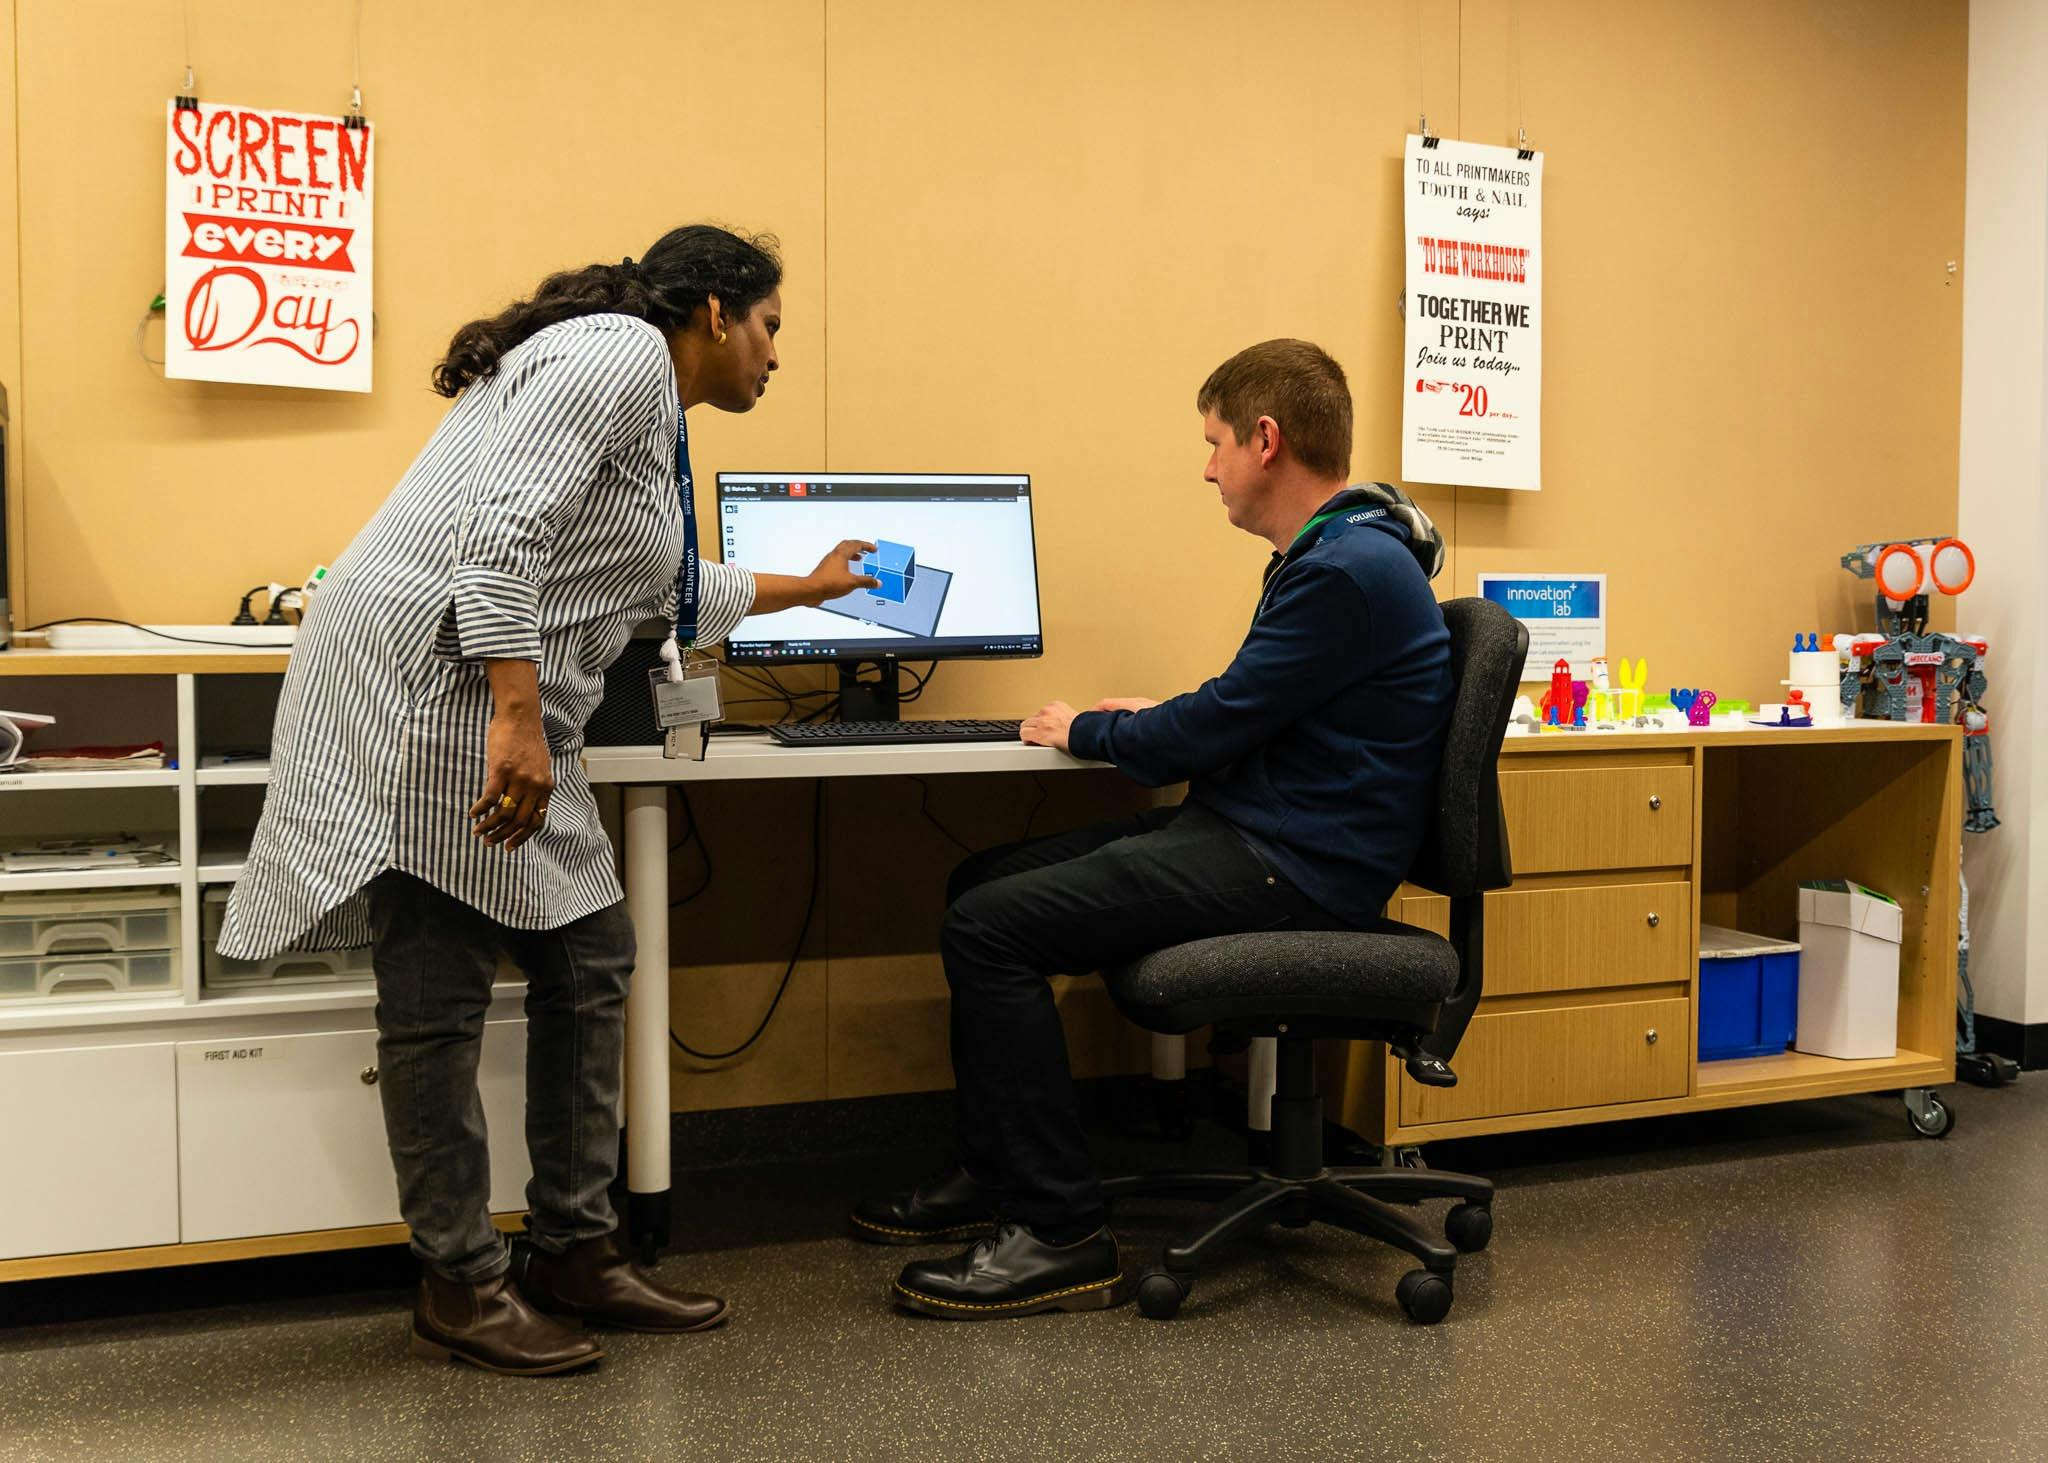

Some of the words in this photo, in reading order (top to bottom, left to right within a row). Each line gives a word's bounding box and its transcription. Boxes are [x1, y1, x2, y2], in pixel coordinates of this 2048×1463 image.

[172, 107, 370, 193] SCREEN
[1416, 158, 1430, 175] TO
[1434, 161, 1452, 177] ALL
[1457, 163, 1530, 187] PRINTMAKERS
[211, 184, 329, 218] PRINT
[1418, 181, 1468, 201] TOOTH
[1475, 188, 1486, 202] &
[1438, 239, 1459, 276] THE
[184, 265, 360, 365] Day
[1417, 293, 1504, 326] TOGETHER
[1504, 303, 1530, 328] WE
[1439, 324, 1509, 353] PRINT
[1416, 346, 1448, 369] Join
[1452, 356, 1467, 368] us
[1451, 382, 1488, 418] $20
[683, 547, 696, 605] VOLUNTEER
[1553, 600, 1572, 617] lab
[1908, 654, 1943, 663] MECCANO
[204, 1050, 230, 1061] FIRST
[232, 1049, 247, 1059] AID
[249, 1047, 263, 1058] KIT
